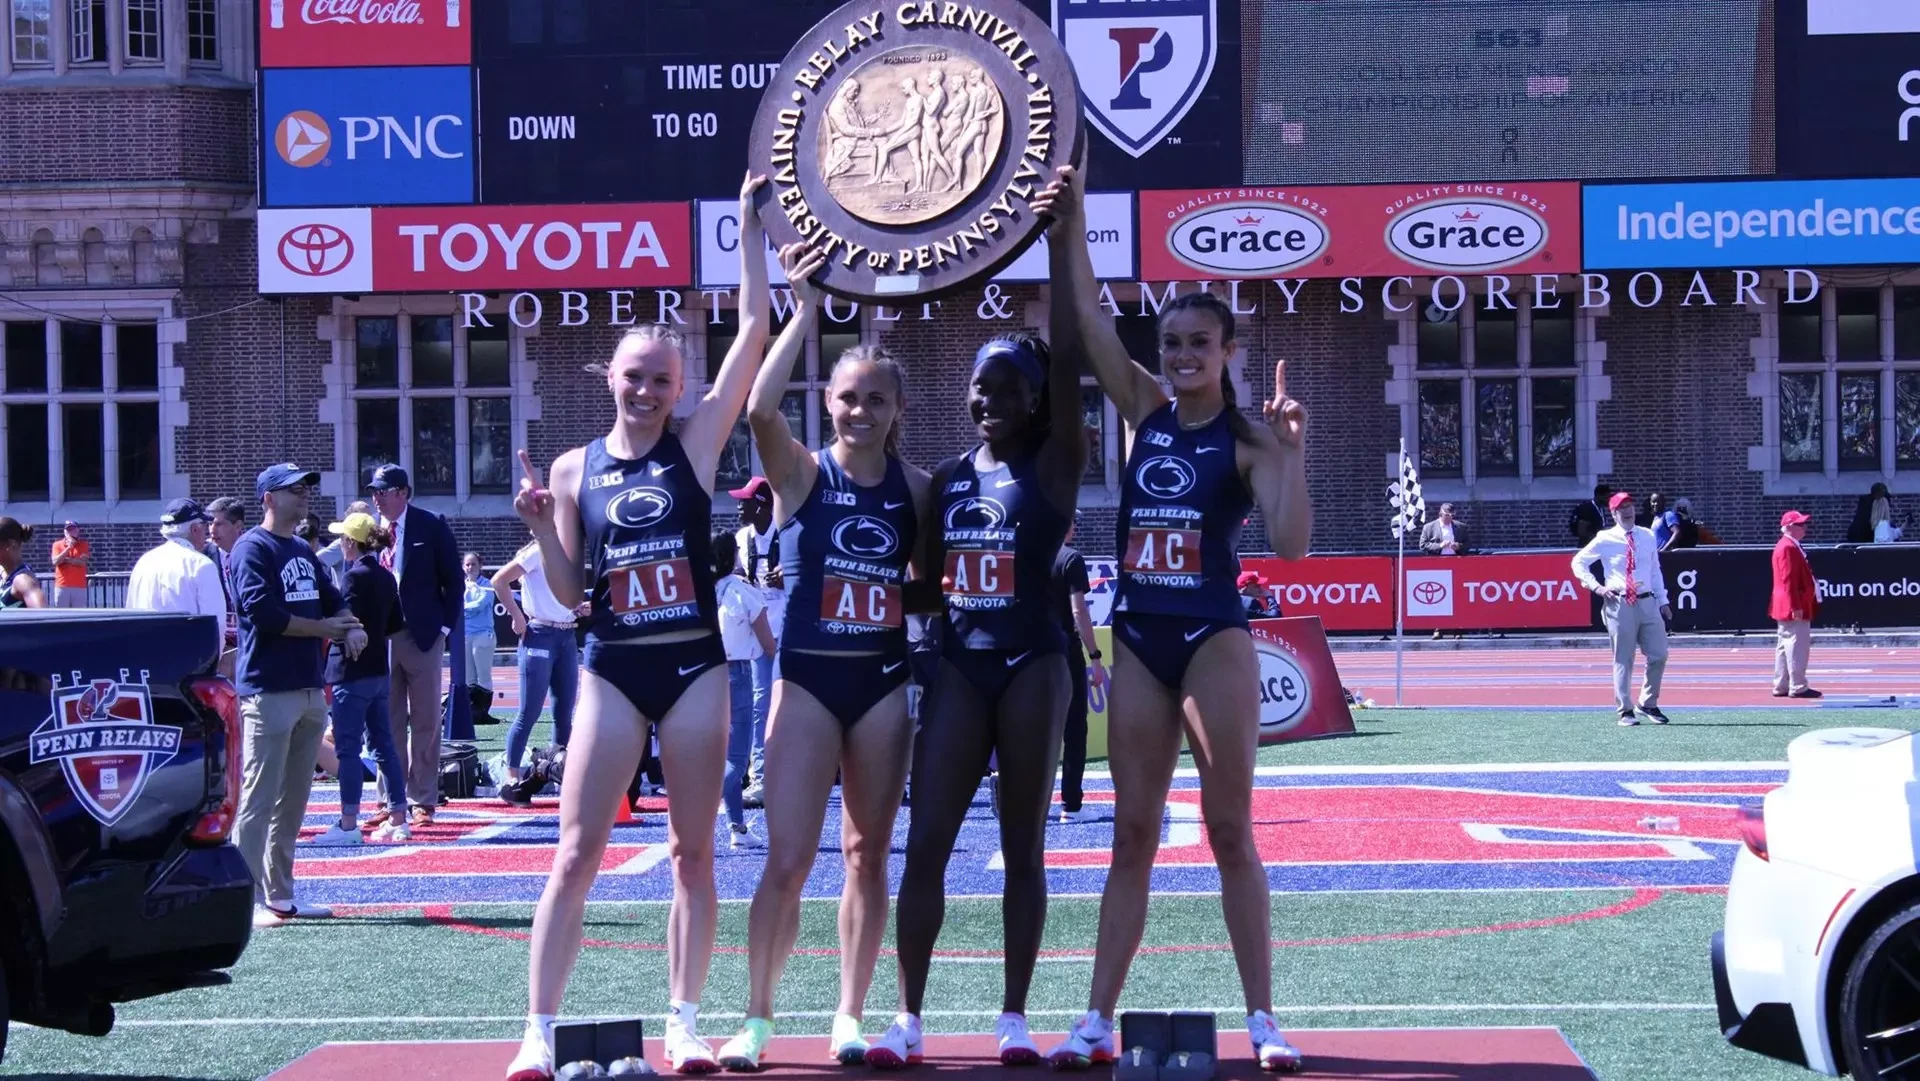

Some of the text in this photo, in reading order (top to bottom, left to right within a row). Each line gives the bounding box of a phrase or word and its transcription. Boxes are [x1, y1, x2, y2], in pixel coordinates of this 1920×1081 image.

[795, 1, 1038, 89] RELAY CARNIVAL
[1473, 28, 1543, 49] 563
[882, 55, 921, 64] FOUNDED
[662, 65, 722, 89] TIME
[1340, 63, 1470, 83] COLLEGE
[1303, 93, 1528, 114] CHAMPIONSHIP
[1586, 87, 1718, 107] AMERICA
[339, 115, 464, 159] PNC
[509, 116, 576, 140] DOWN
[652, 112, 718, 138] TO GO
[771, 108, 865, 267] UNIVERSITY
[898, 84, 1052, 272] PENNSYLVANIA
[1168, 189, 1329, 219] QUALITY SINCE 1922
[1385, 185, 1548, 215] QUALITY SINCE 1922
[399, 221, 670, 271] TOYOTA
[1189, 226, 1306, 253] Grace
[1407, 221, 1525, 249] Grace
[461, 290, 731, 328] ROBERT
[977, 284, 1013, 320] &
[1099, 279, 1309, 317] AMLY
[1340, 268, 1819, 313] SCOREBOARD
[1132, 508, 1201, 519] PENN RELAYS
[945, 531, 1014, 541] PENN RELAYS
[606, 539, 684, 560] PENN RELAYS
[1136, 532, 1184, 570] A C
[825, 557, 857, 570] PENN
[857, 563, 898, 578] RELAYS
[954, 554, 997, 592] A C
[628, 564, 677, 608] A C
[1147, 575, 1194, 586] TOYOTA
[1463, 580, 1578, 603] TOYOTA
[1819, 579, 1854, 597] Run
[1859, 583, 1884, 596] on
[836, 583, 886, 621] A C
[963, 597, 1006, 608] TOYOTA
[1269, 583, 1381, 605] TOYOTA
[642, 606, 691, 622] TOYOTA
[847, 624, 889, 634] TOYO
[36, 730, 177, 757] PENN RELAYS
